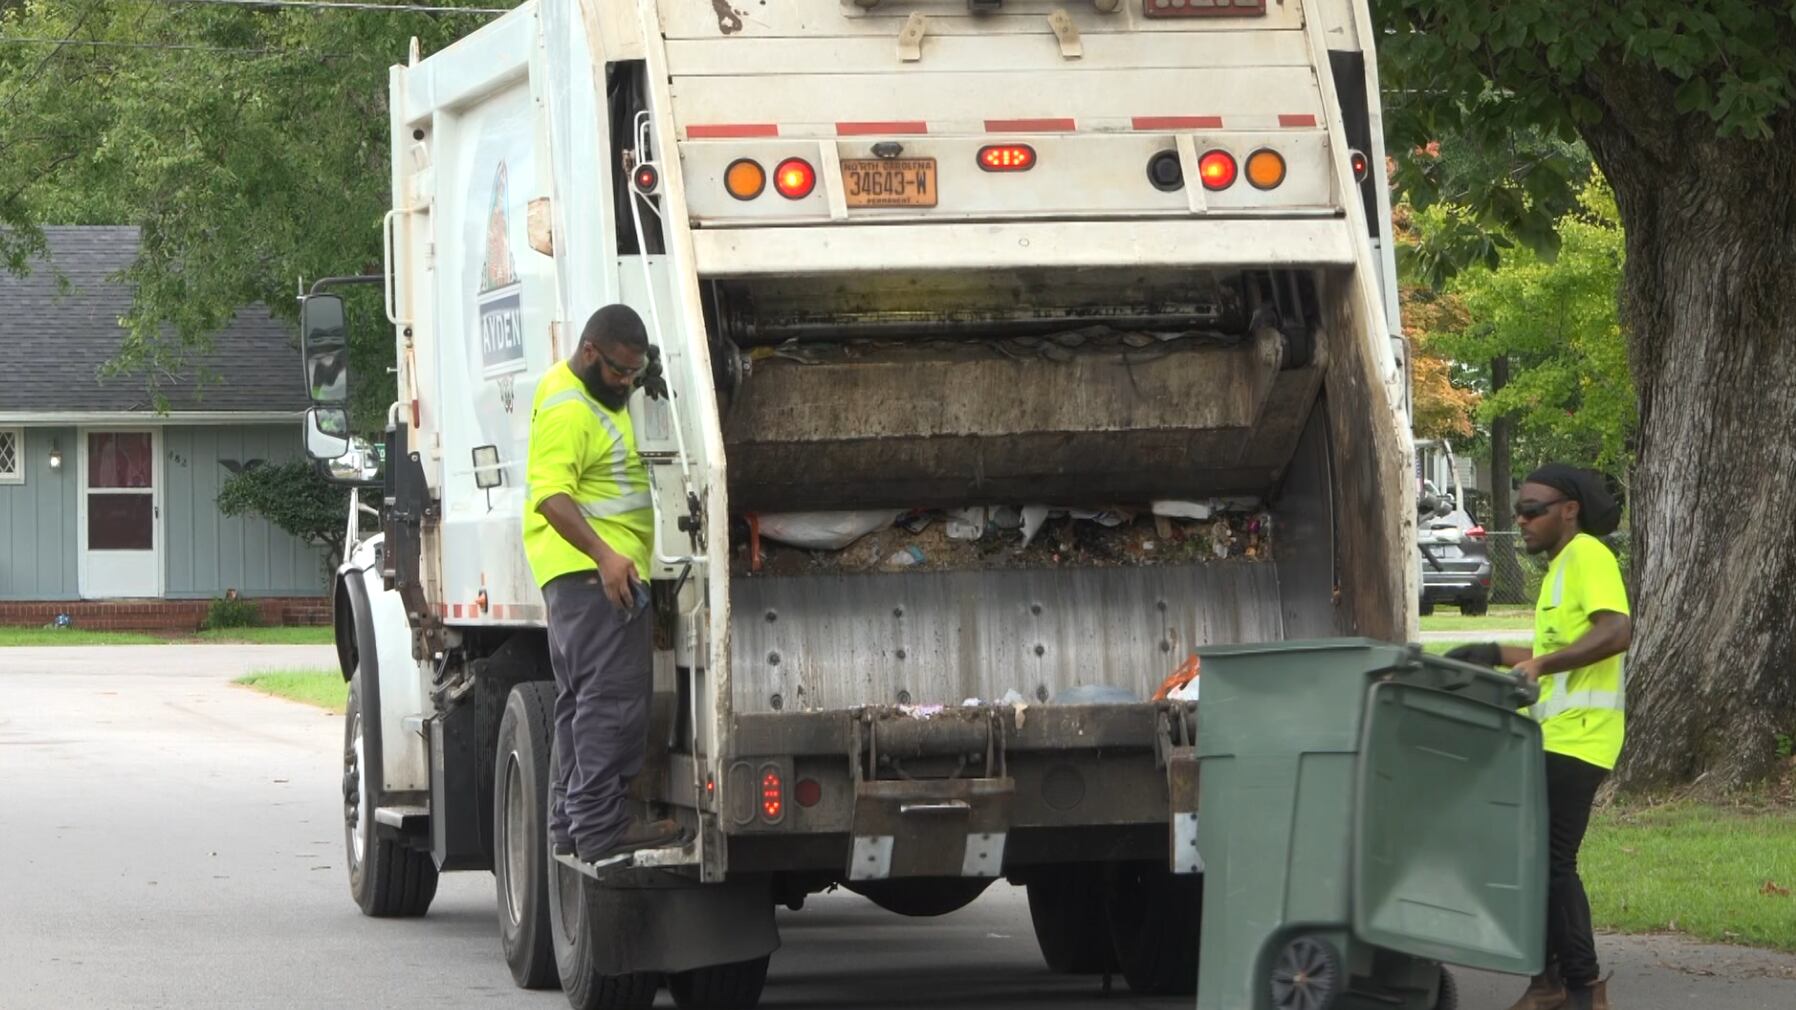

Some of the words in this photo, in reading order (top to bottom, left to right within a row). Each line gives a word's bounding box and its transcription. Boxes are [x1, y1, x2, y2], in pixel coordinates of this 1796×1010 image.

[843, 162, 879, 171] NORTH
[883, 161, 932, 170] CAROLINA
[850, 171, 926, 196] 34643-W
[482, 308, 521, 353] AYDEN
